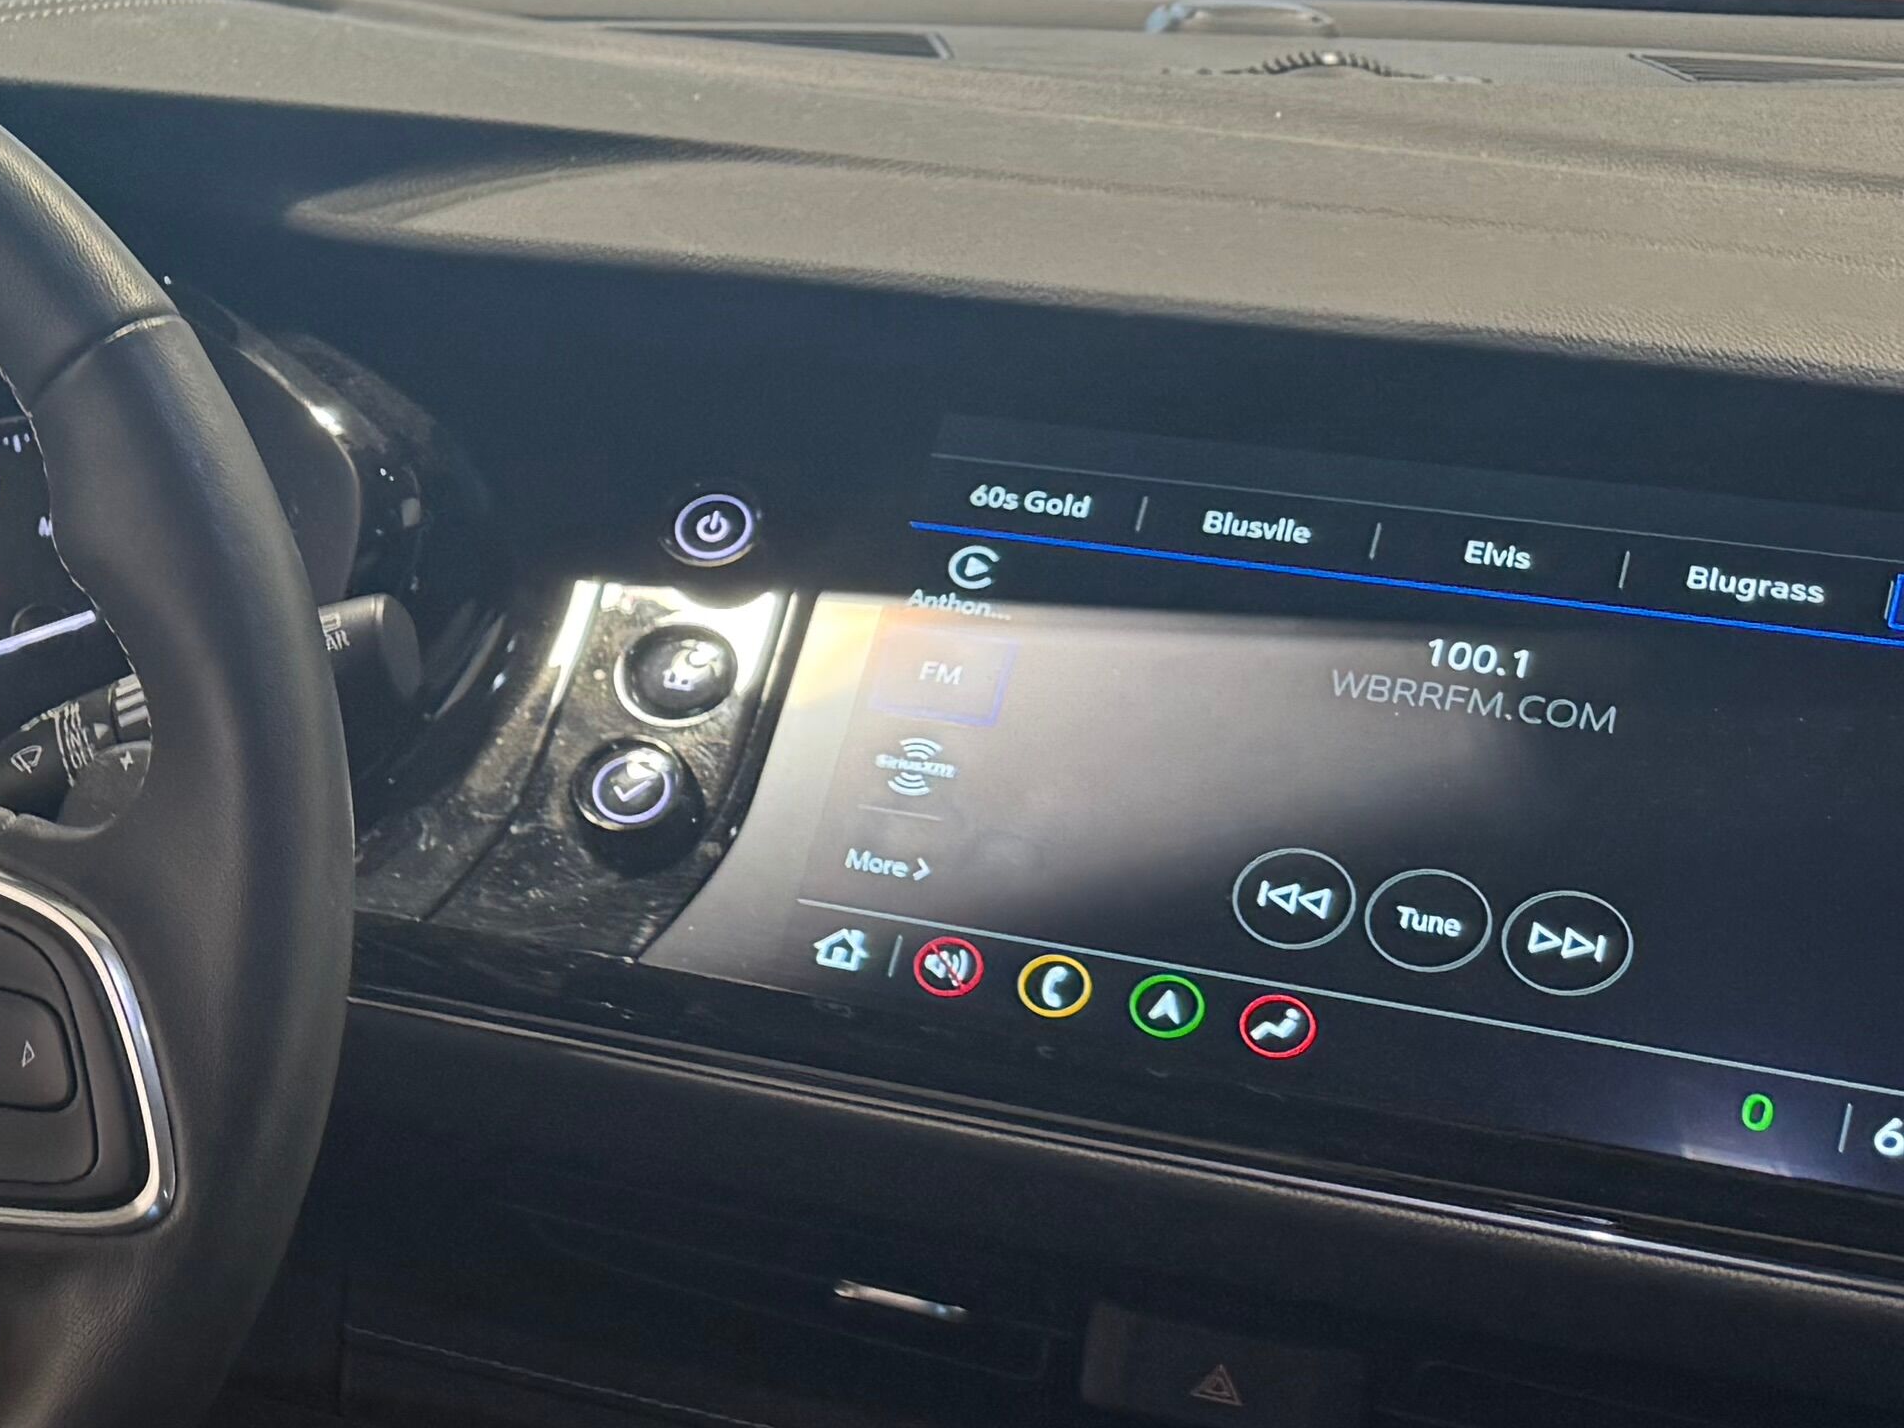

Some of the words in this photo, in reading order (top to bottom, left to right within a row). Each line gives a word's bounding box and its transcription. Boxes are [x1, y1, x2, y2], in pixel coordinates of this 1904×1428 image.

[969, 483, 1019, 511] 60s
[1023, 490, 1092, 519] Gold
[1463, 539, 1532, 571] Elvis
[1685, 565, 1825, 604] Blugrass
[919, 660, 963, 685] FM
[1427, 637, 1532, 679] 100.1
[1332, 669, 1617, 735] WBRRFM.COM
[844, 848, 908, 878] More
[1396, 905, 1462, 938] Tune
[1741, 1093, 1775, 1132] 0
